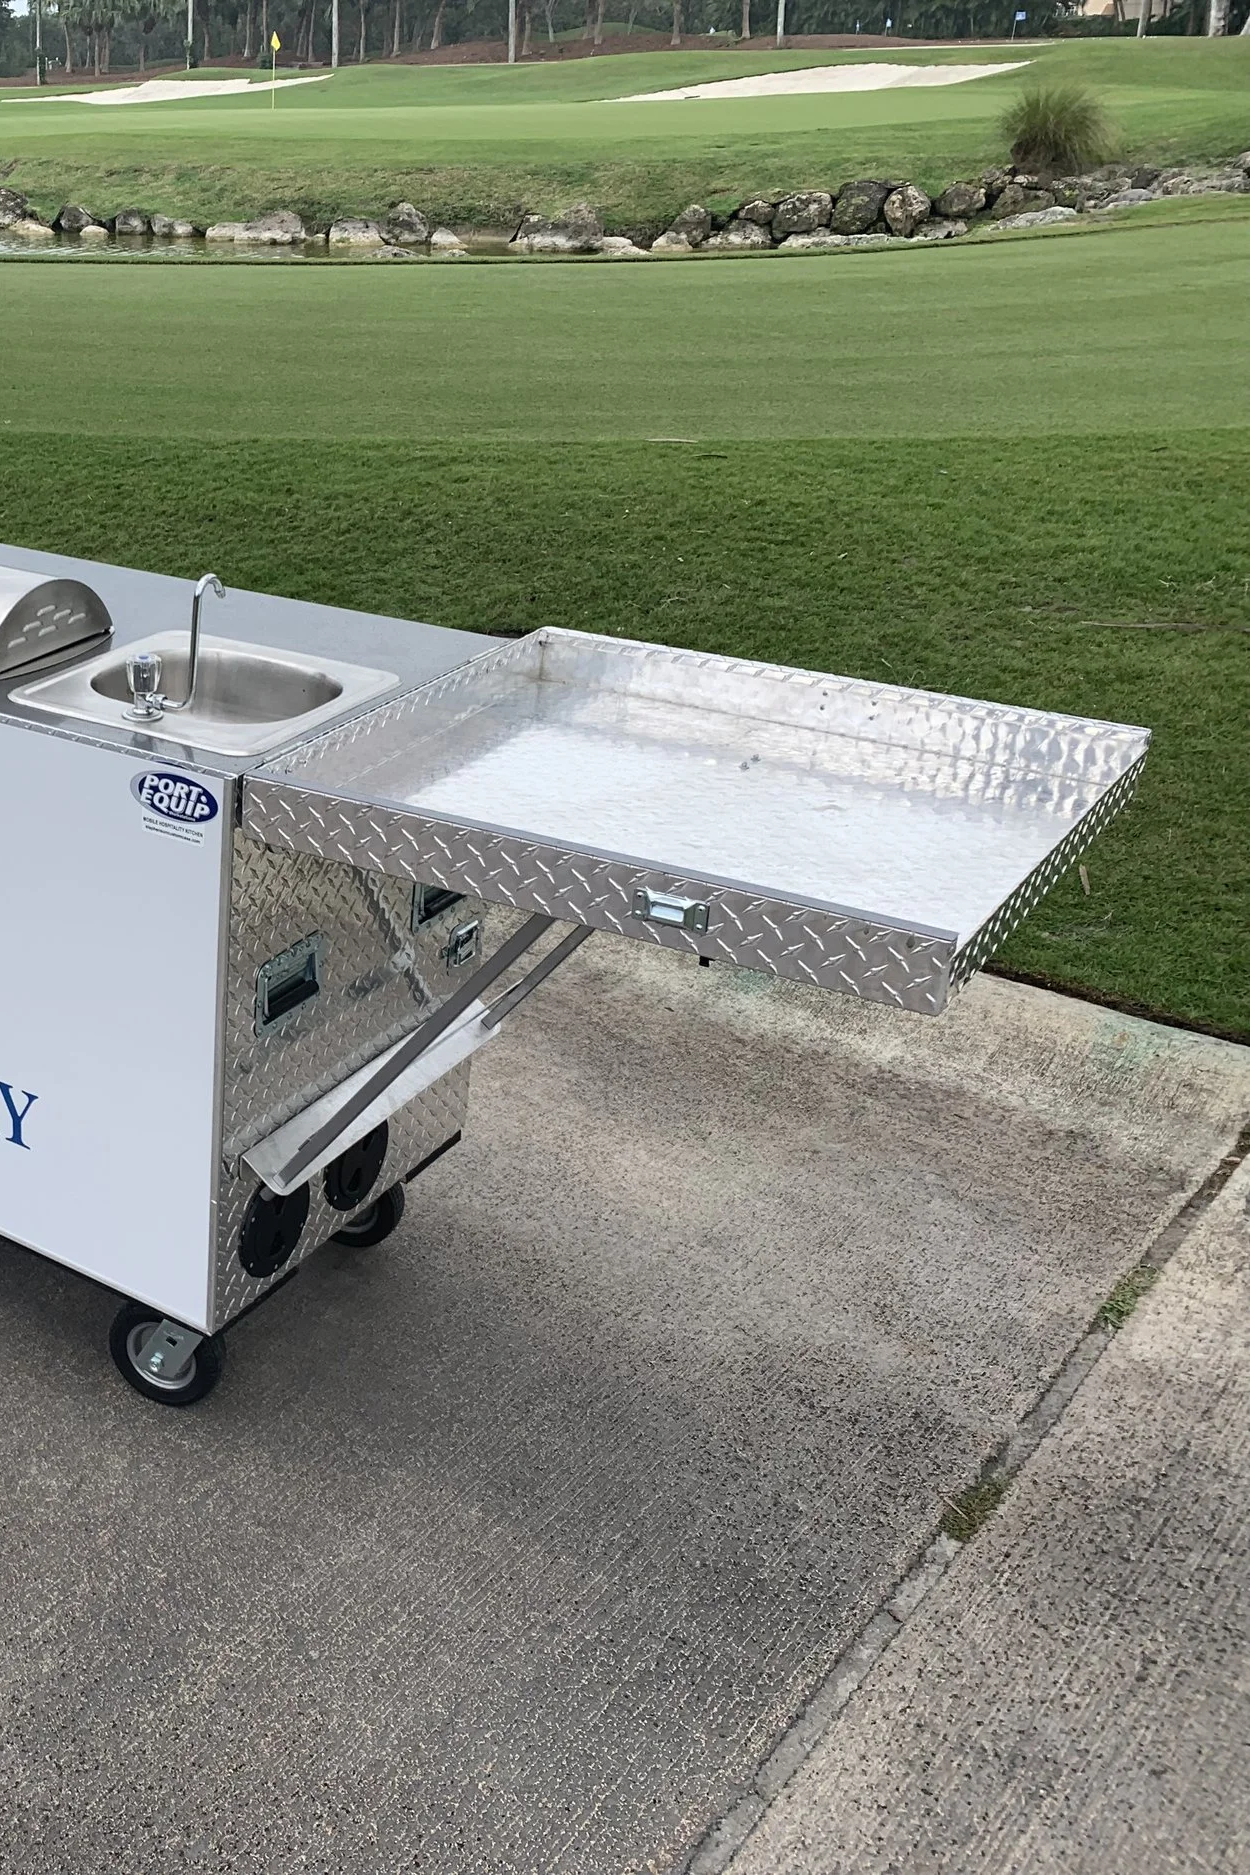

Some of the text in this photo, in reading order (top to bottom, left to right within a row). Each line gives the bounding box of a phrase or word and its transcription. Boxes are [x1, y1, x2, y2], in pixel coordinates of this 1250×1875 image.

[140, 788, 210, 818] EQUIP
[142, 816, 158, 826] MOBILE
[158, 821, 185, 833] HOSPITALITY
[184, 828, 204, 838] KITCHEN
